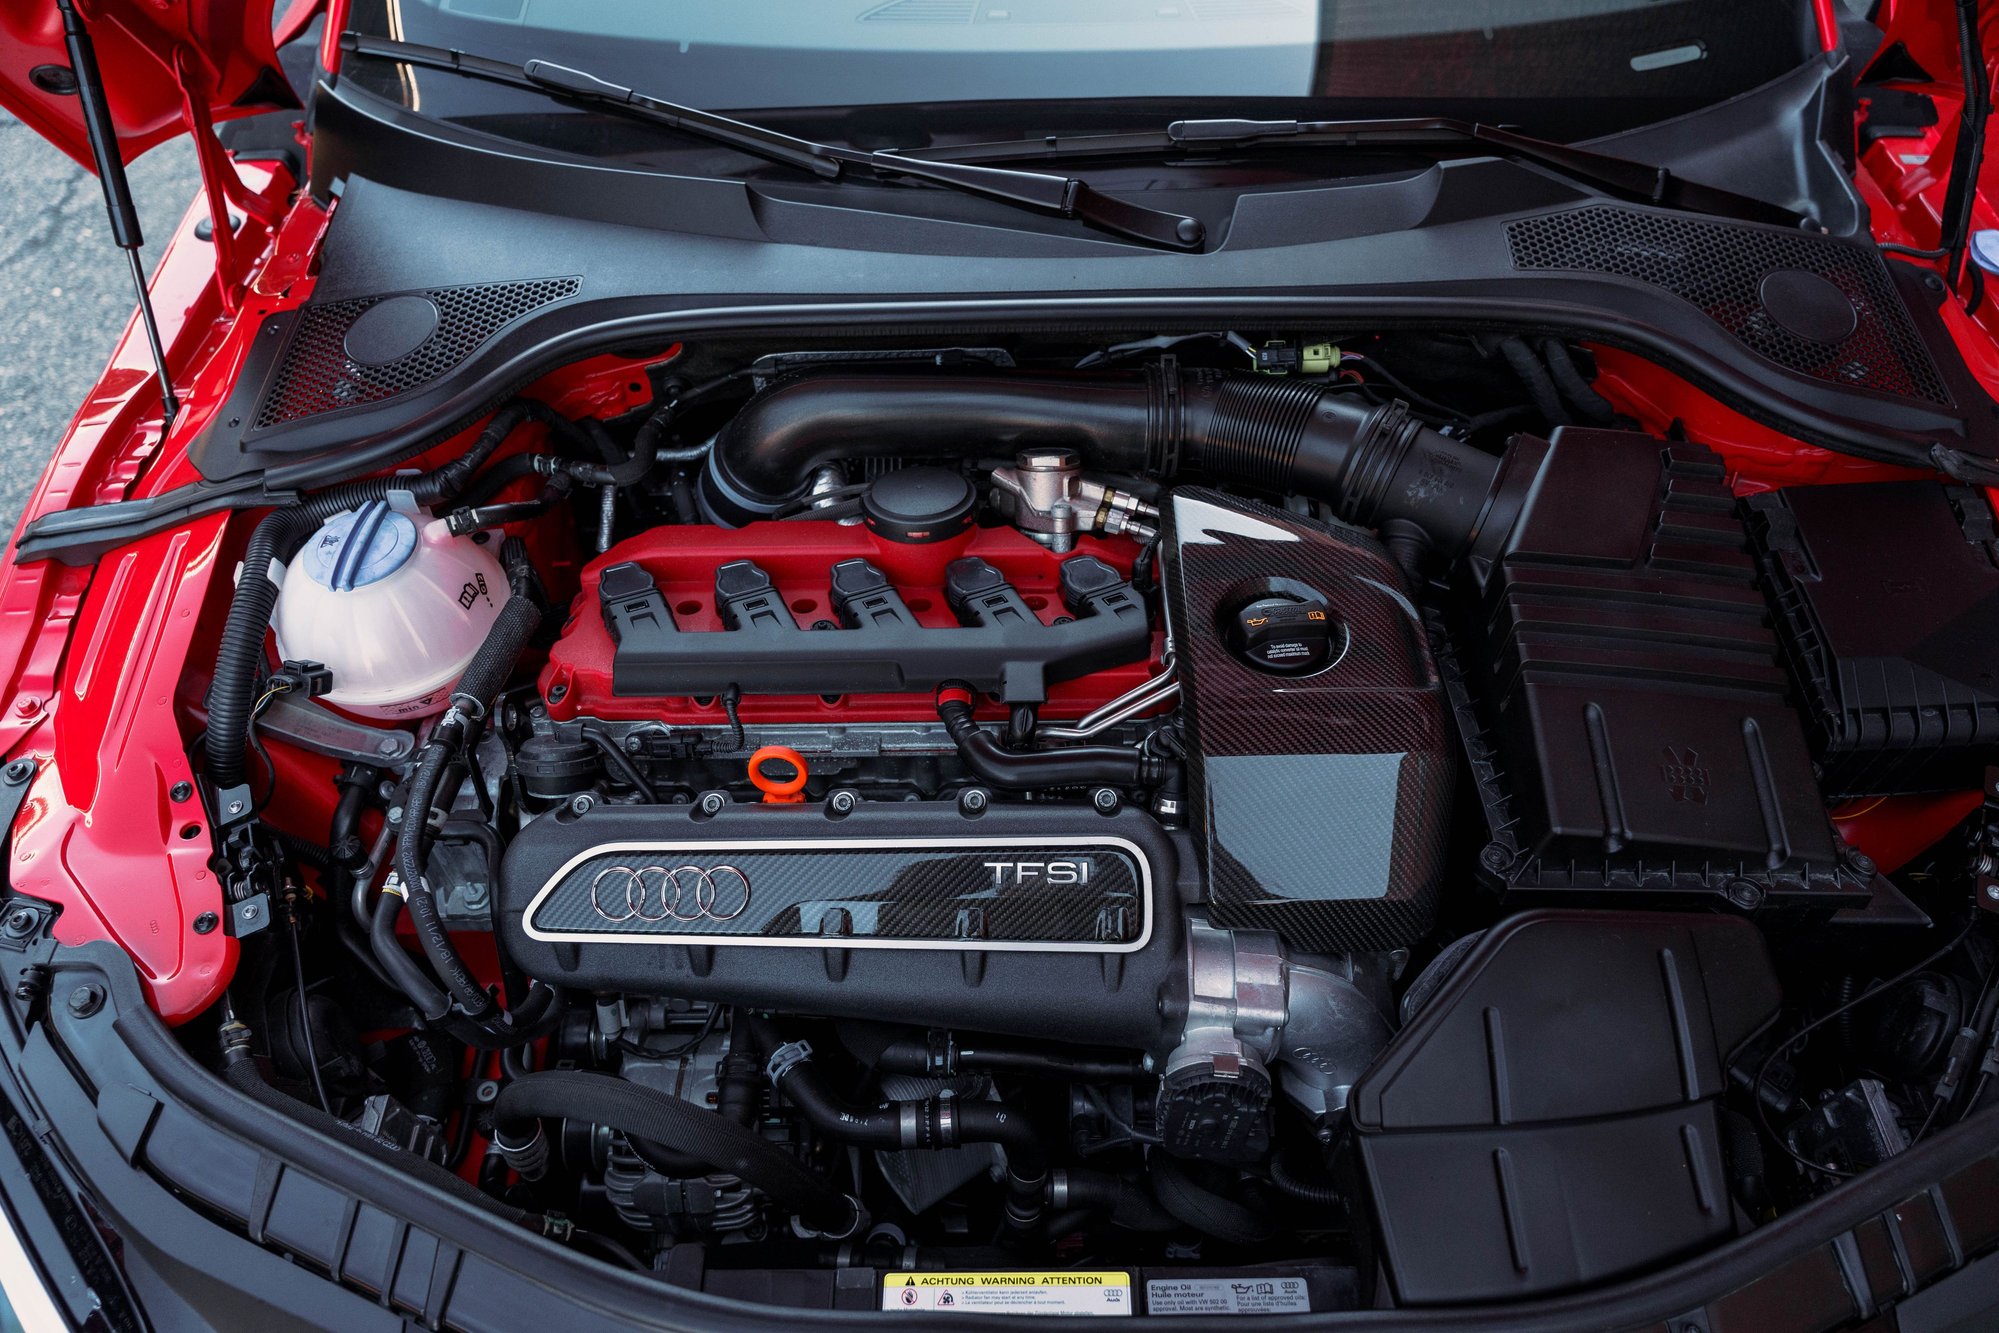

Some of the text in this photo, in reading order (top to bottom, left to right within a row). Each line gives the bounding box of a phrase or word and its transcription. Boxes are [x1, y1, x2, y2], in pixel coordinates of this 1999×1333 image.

[398, 704, 420, 713] min
[984, 862, 1088, 884] TFSI
[425, 921, 454, 964] 18/12/11
[921, 1276, 1103, 1286] ACHTUNG WARNING ATTENTION
[1151, 1284, 1179, 1292] Engine
